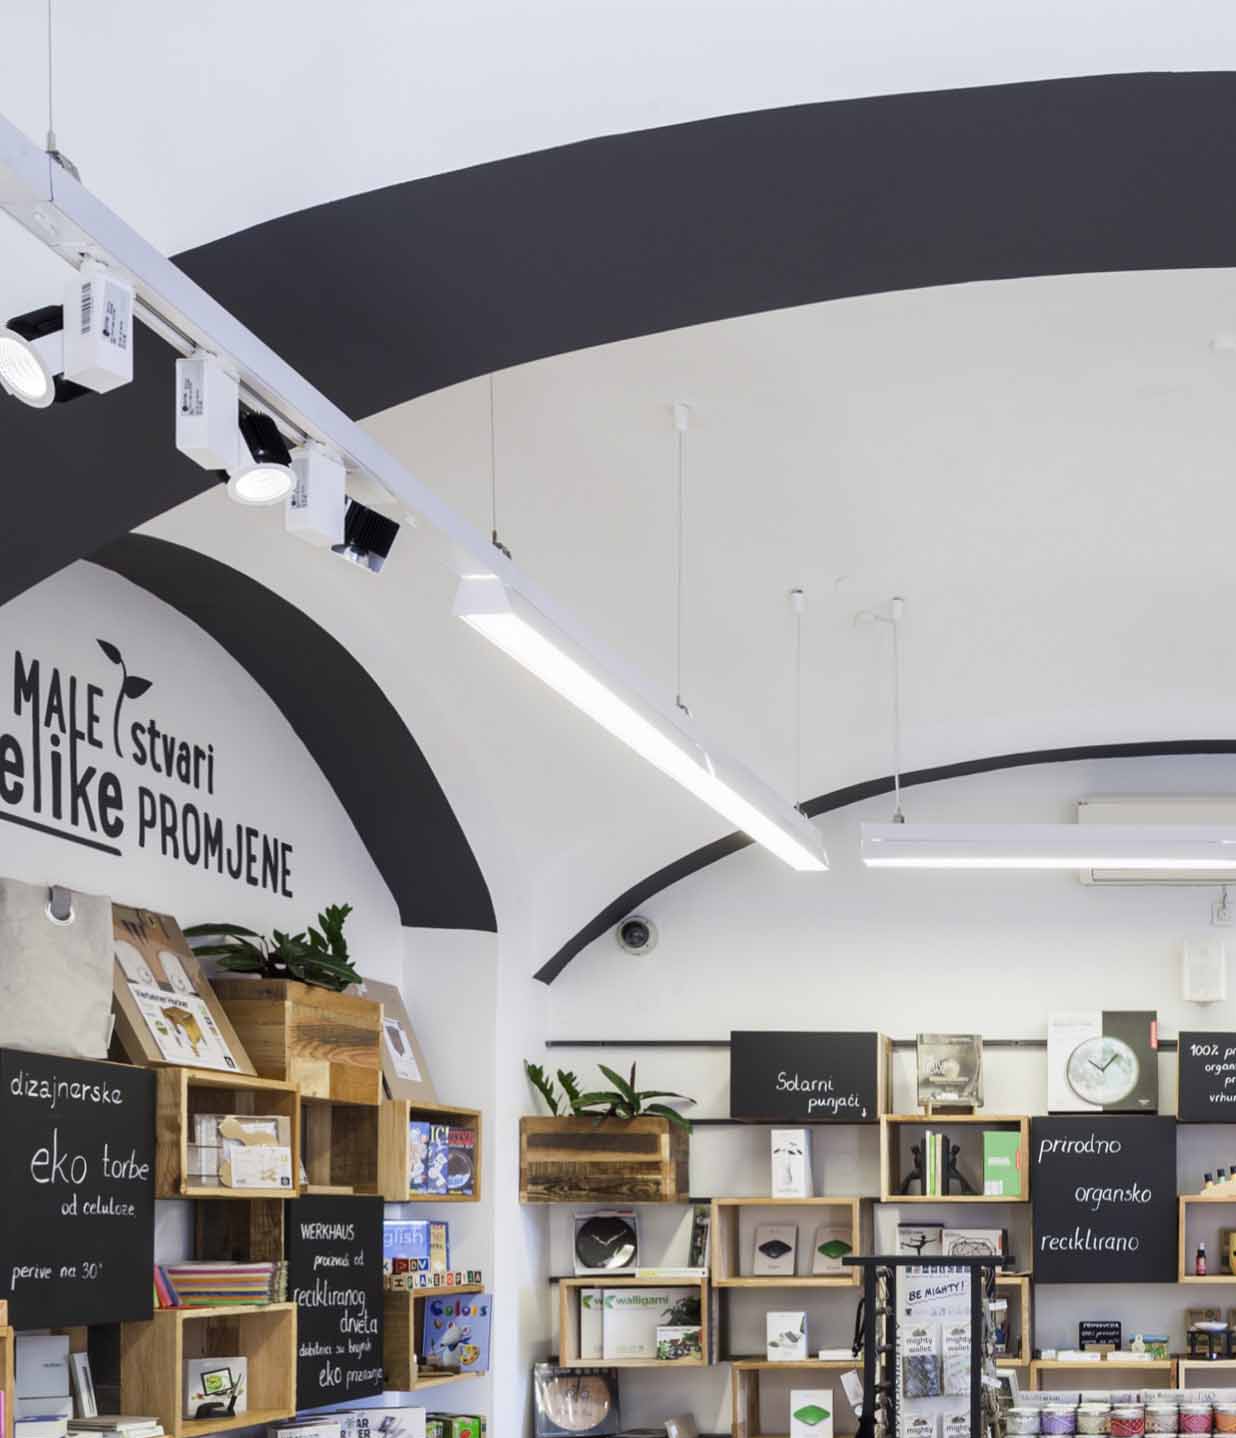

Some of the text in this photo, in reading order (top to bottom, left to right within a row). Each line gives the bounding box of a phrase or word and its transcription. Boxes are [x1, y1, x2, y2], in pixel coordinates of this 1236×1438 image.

[14, 650, 214, 794] MALE stvari
[0, 734, 293, 898] elike PROMJENE
[1190, 1044, 1219, 1056] 100%
[10, 1069, 123, 1109] dizajnerske
[776, 1071, 834, 1092] Solarni
[30, 1128, 150, 1184] eko torbe
[1038, 1133, 1122, 1164] prirodno
[61, 1193, 77, 1216] od
[1075, 1183, 1152, 1211] organsko
[301, 1223, 355, 1241] WERKHAUS
[383, 1230, 424, 1249] glish
[1040, 1226, 1139, 1252] reciklirano
[353, 1249, 365, 1266] od
[11, 1264, 52, 1290] perive
[60, 1268, 77, 1278] na
[293, 1277, 366, 1316] recikliranog
[430, 1300, 488, 1316] Colors
[908, 1290, 922, 1301] BE
[340, 1309, 378, 1334] drveta
[319, 1360, 342, 1387] eko
